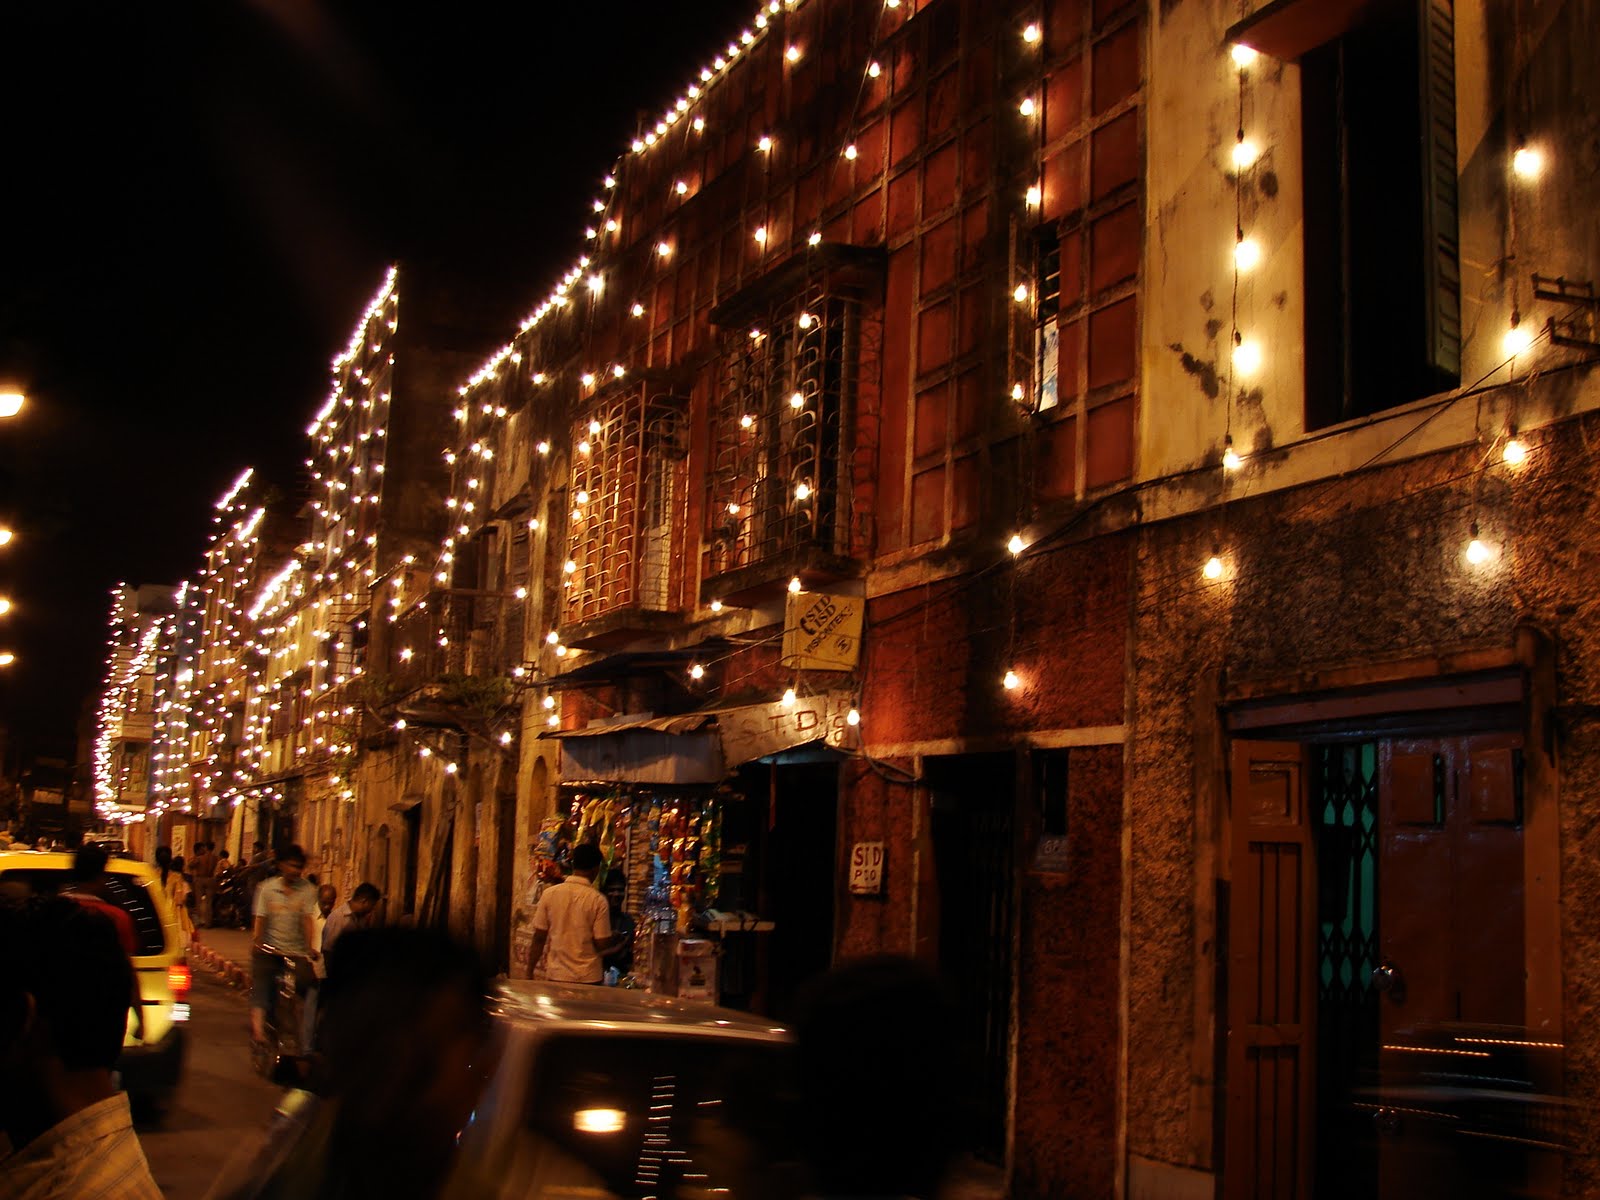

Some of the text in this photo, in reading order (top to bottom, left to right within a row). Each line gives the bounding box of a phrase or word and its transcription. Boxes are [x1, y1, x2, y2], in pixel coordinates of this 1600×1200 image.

[806, 595, 831, 622] STD
[813, 604, 836, 628] ISD
[854, 846, 882, 867] STD
